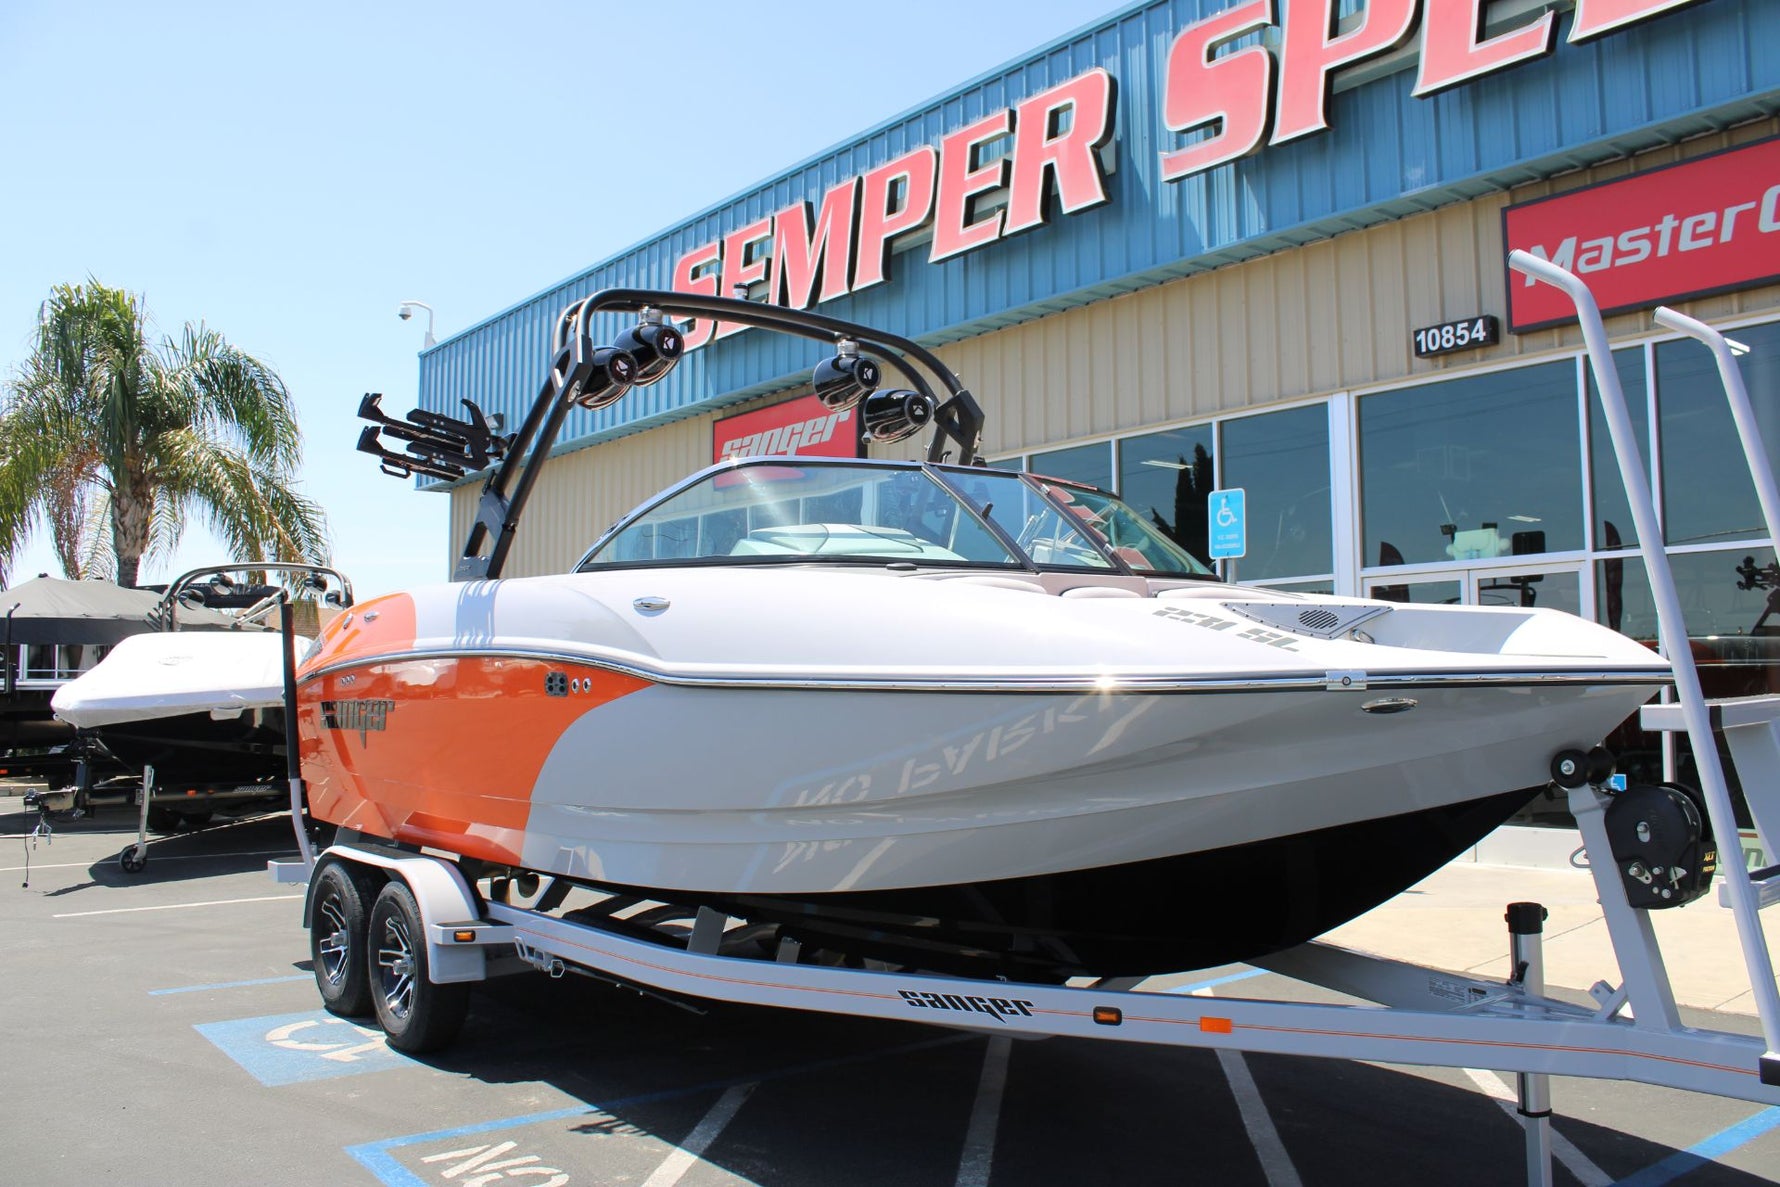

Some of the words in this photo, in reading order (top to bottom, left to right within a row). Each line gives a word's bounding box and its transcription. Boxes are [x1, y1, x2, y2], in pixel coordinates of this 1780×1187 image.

[671, 67, 1117, 354] SEMPER
[1160, 0, 1702, 183] SP
[1416, 320, 1486, 353] 10854
[1236, 627, 1300, 653] SL
[897, 989, 1035, 1025] sanger
